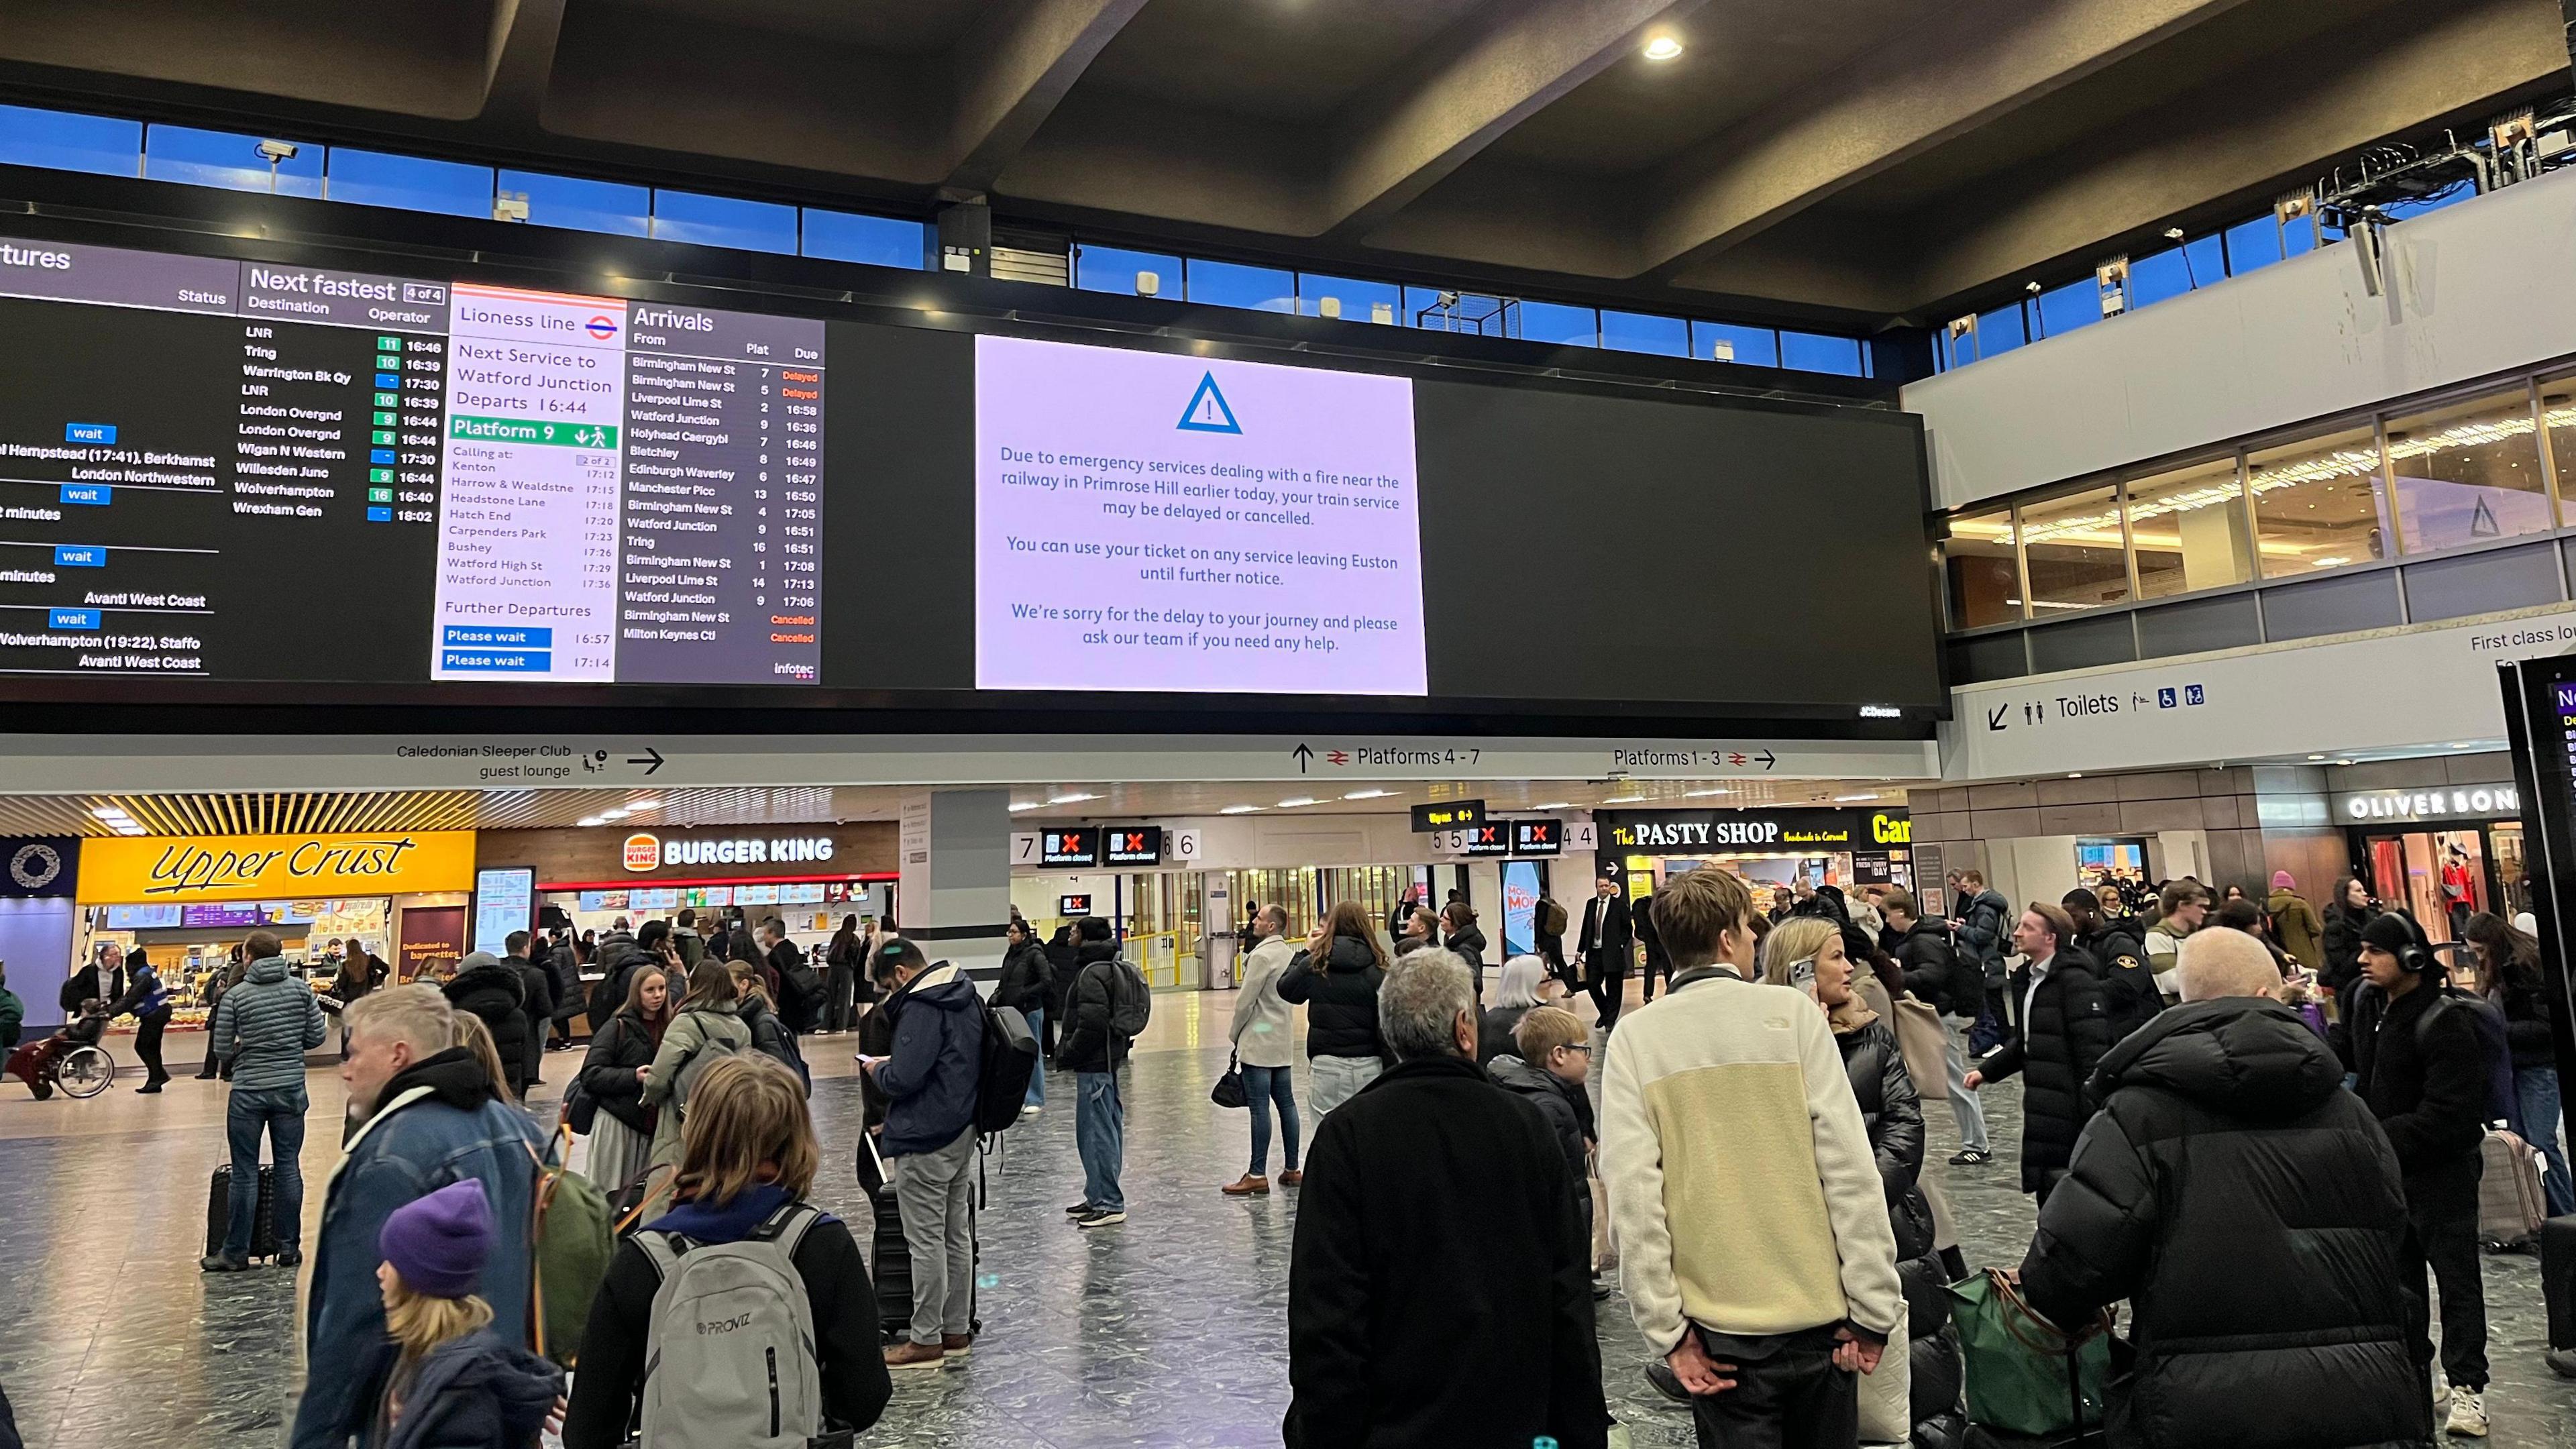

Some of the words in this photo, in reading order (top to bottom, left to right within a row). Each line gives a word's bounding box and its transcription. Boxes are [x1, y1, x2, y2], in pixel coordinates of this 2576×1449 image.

[250, 268, 309, 293] Next
[312, 274, 396, 301] fastest
[178, 289, 227, 305] Status
[419, 290, 431, 300] of
[433, 291, 441, 300] 4
[248, 295, 329, 315] Destination
[368, 307, 431, 324] Operator
[461, 307, 533, 327] Lioness
[541, 315, 575, 331] line
[633, 307, 713, 332] Arrivals
[633, 332, 666, 345] From
[459, 344, 503, 361] Next
[508, 348, 572, 367] Service
[578, 356, 596, 368] to
[746, 343, 769, 356] Plat
[794, 347, 818, 360] Due
[458, 368, 532, 386] Watford
[537, 375, 612, 393] Junction
[457, 391, 527, 409] Departs
[540, 398, 586, 414] 16:44
[73, 429, 103, 439] wait
[454, 419, 537, 439] Platform
[543, 425, 555, 440] 9
[8, 443, 87, 460] Hempstead
[144, 451, 215, 468] Berkhamst
[629, 463, 684, 478] Edinburgh
[685, 467, 735, 482] Waverley
[759, 472, 767, 482] 6
[1001, 447, 1033, 463] Due
[1038, 451, 1055, 464] to
[1059, 455, 1144, 474] emergency
[1148, 460, 1206, 475] services
[1210, 462, 1263, 483] dealing
[1267, 468, 1299, 482] with
[1303, 473, 1311, 482] a
[1316, 470, 1338, 484] fire
[1342, 476, 1373, 487] near
[1377, 474, 1399, 489] the
[785, 474, 816, 485] 16:47
[234, 482, 335, 498] Wolverhampton
[373, 490, 387, 501] 16
[398, 491, 434, 503] 16:40
[1002, 471, 1059, 491] railway
[1065, 474, 1078, 488] in
[1083, 475, 1150, 493] Primrose
[1155, 480, 1179, 495] Hill
[1183, 484, 1230, 498] earlier
[1234, 486, 1278, 505] today,
[1281, 492, 1313, 506] your
[1317, 492, 1349, 506] train
[1353, 496, 1399, 510] service
[449, 509, 484, 520] Hatch
[488, 511, 511, 521] End
[586, 517, 613, 526] 17:20
[1104, 503, 1136, 519] may
[1141, 501, 1159, 517] be
[1163, 503, 1221, 523] delayed
[1226, 511, 1240, 521] or
[1244, 510, 1314, 525] cancelled.
[1006, 536, 1036, 551] You
[1041, 541, 1069, 553] can
[1075, 543, 1101, 555] use
[1106, 545, 1140, 559] your
[1144, 543, 1187, 559] ticket
[1190, 549, 1209, 559] on
[1214, 550, 1240, 565] any
[1244, 550, 1293, 564] service
[1297, 551, 1347, 570] leaving
[1352, 554, 1398, 569] Euston
[1140, 566, 1174, 580] until
[1179, 567, 1231, 583] further
[1236, 572, 1283, 586] notice.
[1011, 603, 1059, 619] We're
[1063, 609, 1103, 625] sorry
[1107, 606, 1129, 621] for
[1134, 607, 1159, 623] the
[1163, 608, 1204, 628] delay
[1209, 611, 1224, 625] to
[1228, 614, 1261, 629] your
[1263, 612, 1319, 631] journey
[1323, 614, 1349, 629] and
[1354, 615, 1397, 633] please
[447, 630, 492, 641] Please
[495, 632, 526, 642] wait
[576, 634, 610, 644] 16:57
[1083, 629, 1108, 644] ask
[1114, 633, 1139, 645] our
[1143, 632, 1183, 646] team
[1189, 631, 1199, 646] if
[1203, 636, 1230, 651] you
[1235, 634, 1269, 648] need
[1275, 638, 1300, 653] any
[1305, 635, 1339, 653] help.
[2471, 634, 2508, 651] First
[2512, 630, 2554, 646] class
[2055, 694, 2118, 718] Toilets
[396, 745, 478, 757] Caledonian
[482, 745, 537, 759] Sleeper
[539, 745, 572, 757] Club
[1358, 747, 1440, 765] Platforms
[1444, 748, 1455, 765] 4
[1470, 749, 1480, 765] 7
[1614, 749, 1688, 765] Platforms
[1691, 750, 1697, 765] 1
[1711, 750, 1721, 765] 3
[480, 766, 519, 780] guest
[523, 765, 570, 779] lounge
[2349, 793, 2447, 819] OLIVER
[2453, 789, 2521, 814] BON
[1434, 831, 1442, 849] 5
[1451, 831, 1462, 848] 5
[1563, 828, 1572, 846] 4
[1580, 827, 1592, 845] 4
[1635, 823, 1711, 845] PASTY
[1717, 822, 1778, 844] SHOP
[627, 845, 657, 853] BURGER
[664, 839, 767, 865] BURGER
[770, 838, 833, 862] KING
[1020, 838, 1034, 859] 7
[1164, 836, 1171, 855] 6
[1180, 835, 1193, 854] 6
[143, 844, 284, 894] Upper
[288, 837, 417, 876] Crust
[627, 853, 656, 863] KING
[1874, 867, 1888, 877] DAY
[1507, 896, 1538, 912] MOR
[707, 1311, 751, 1336] PROVIZ
